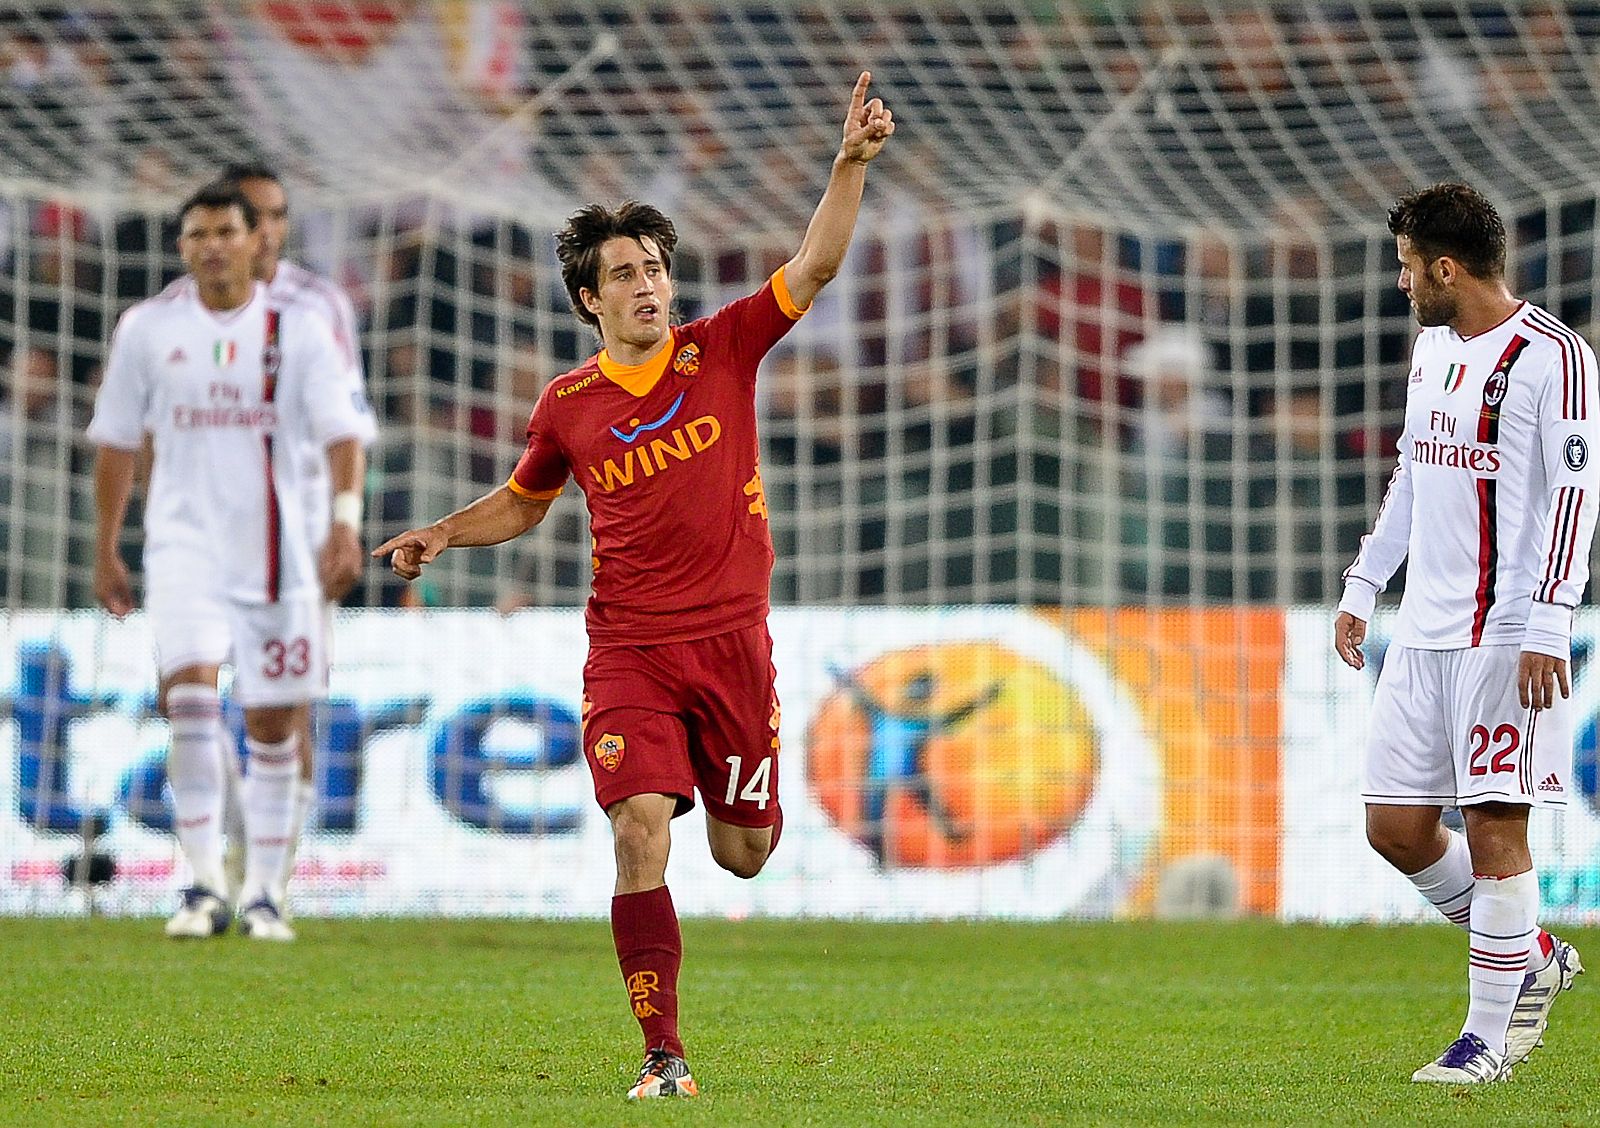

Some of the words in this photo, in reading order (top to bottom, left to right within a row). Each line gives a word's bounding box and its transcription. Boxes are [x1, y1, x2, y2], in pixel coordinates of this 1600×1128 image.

[556, 372, 600, 398] Kappa
[1430, 411, 1457, 438] Fly
[588, 415, 722, 492] WIND
[1411, 435, 1501, 472] mirates
[262, 638, 310, 680] 33
[1469, 723, 1520, 776] 22
[725, 755, 772, 810] 14
